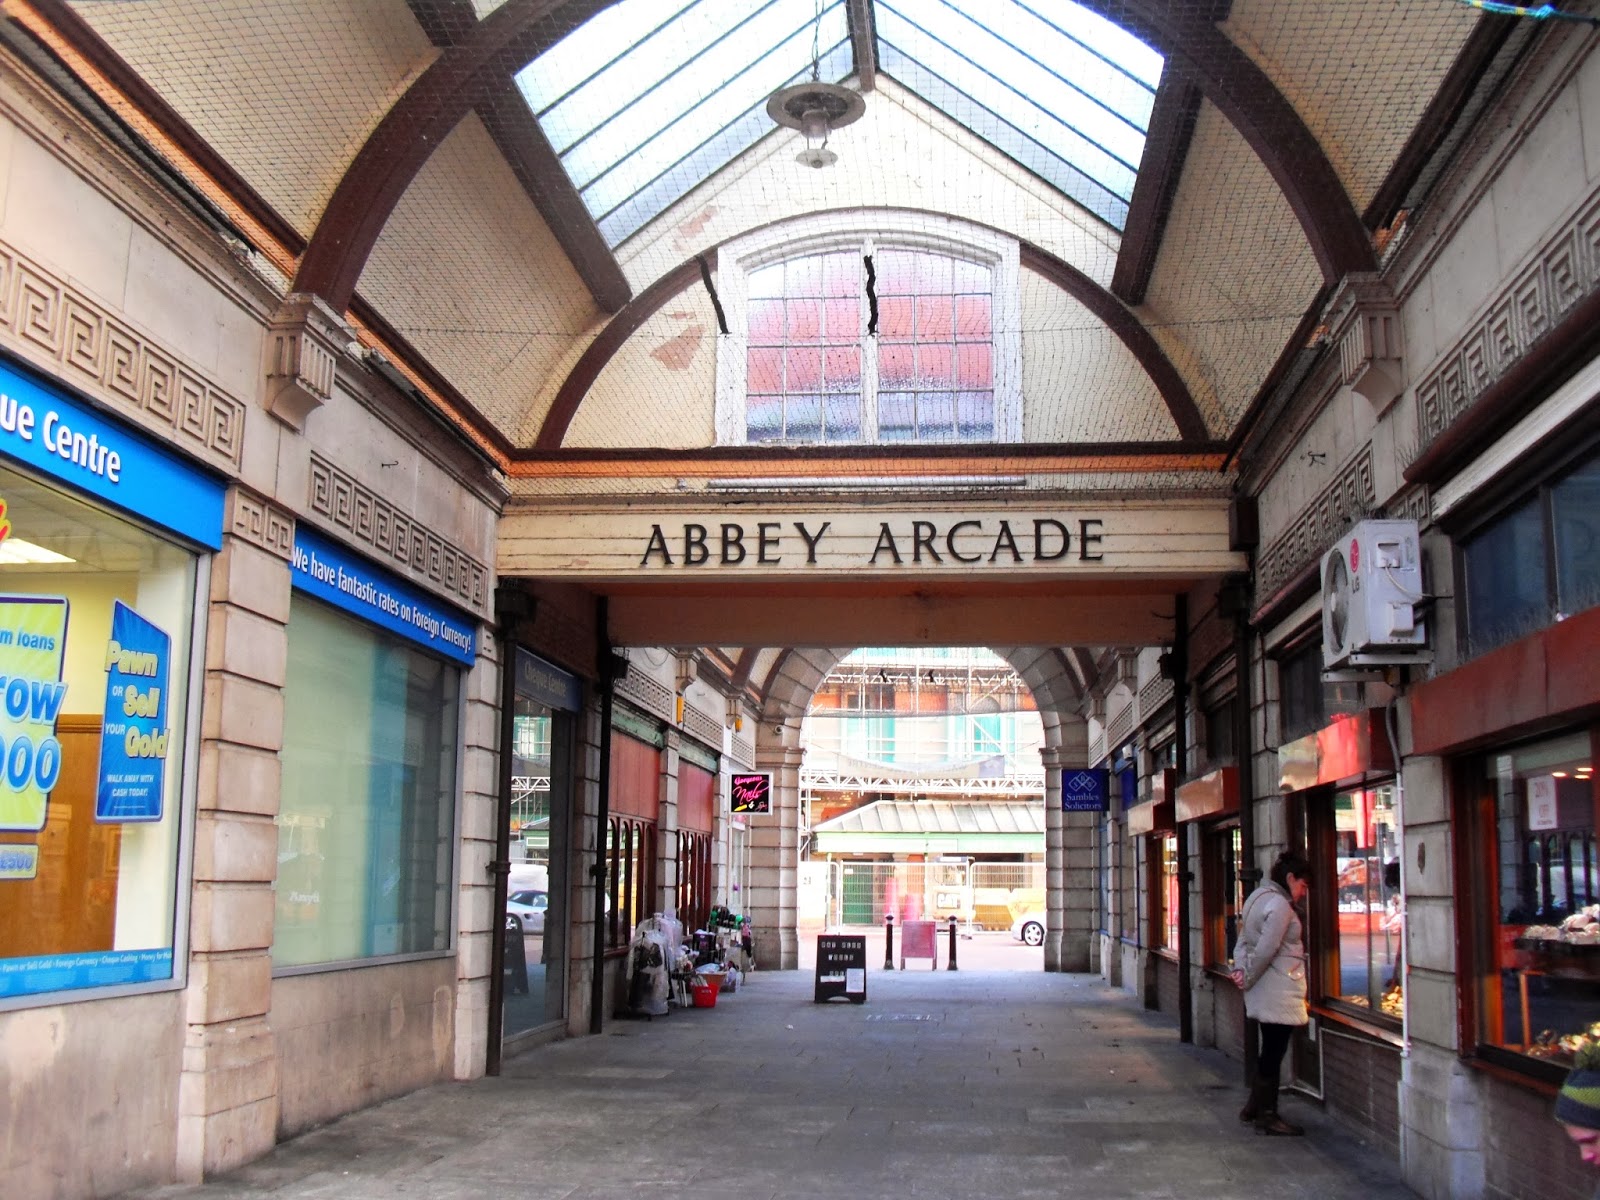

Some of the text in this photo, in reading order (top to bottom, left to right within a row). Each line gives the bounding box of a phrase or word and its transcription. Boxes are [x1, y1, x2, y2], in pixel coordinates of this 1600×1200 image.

[43, 411, 121, 483] Centre
[640, 519, 1103, 565] ABBEY ARCADE
[1352, 576, 1360, 594] LG
[292, 546, 471, 654] We have fantastic rates on Foreign Currency!
[17, 628, 55, 651] loans
[105, 640, 158, 678] Pawn
[112, 685, 161, 718] OR Sell
[105, 723, 170, 759] YOUR Gold
[107, 774, 154, 783] WALK AWAY WITH
[112, 788, 128, 797] CASH
[1066, 793, 1099, 801] Sambles
[1065, 802, 1102, 810] Solicitors
[141, 953, 155, 962] Money
